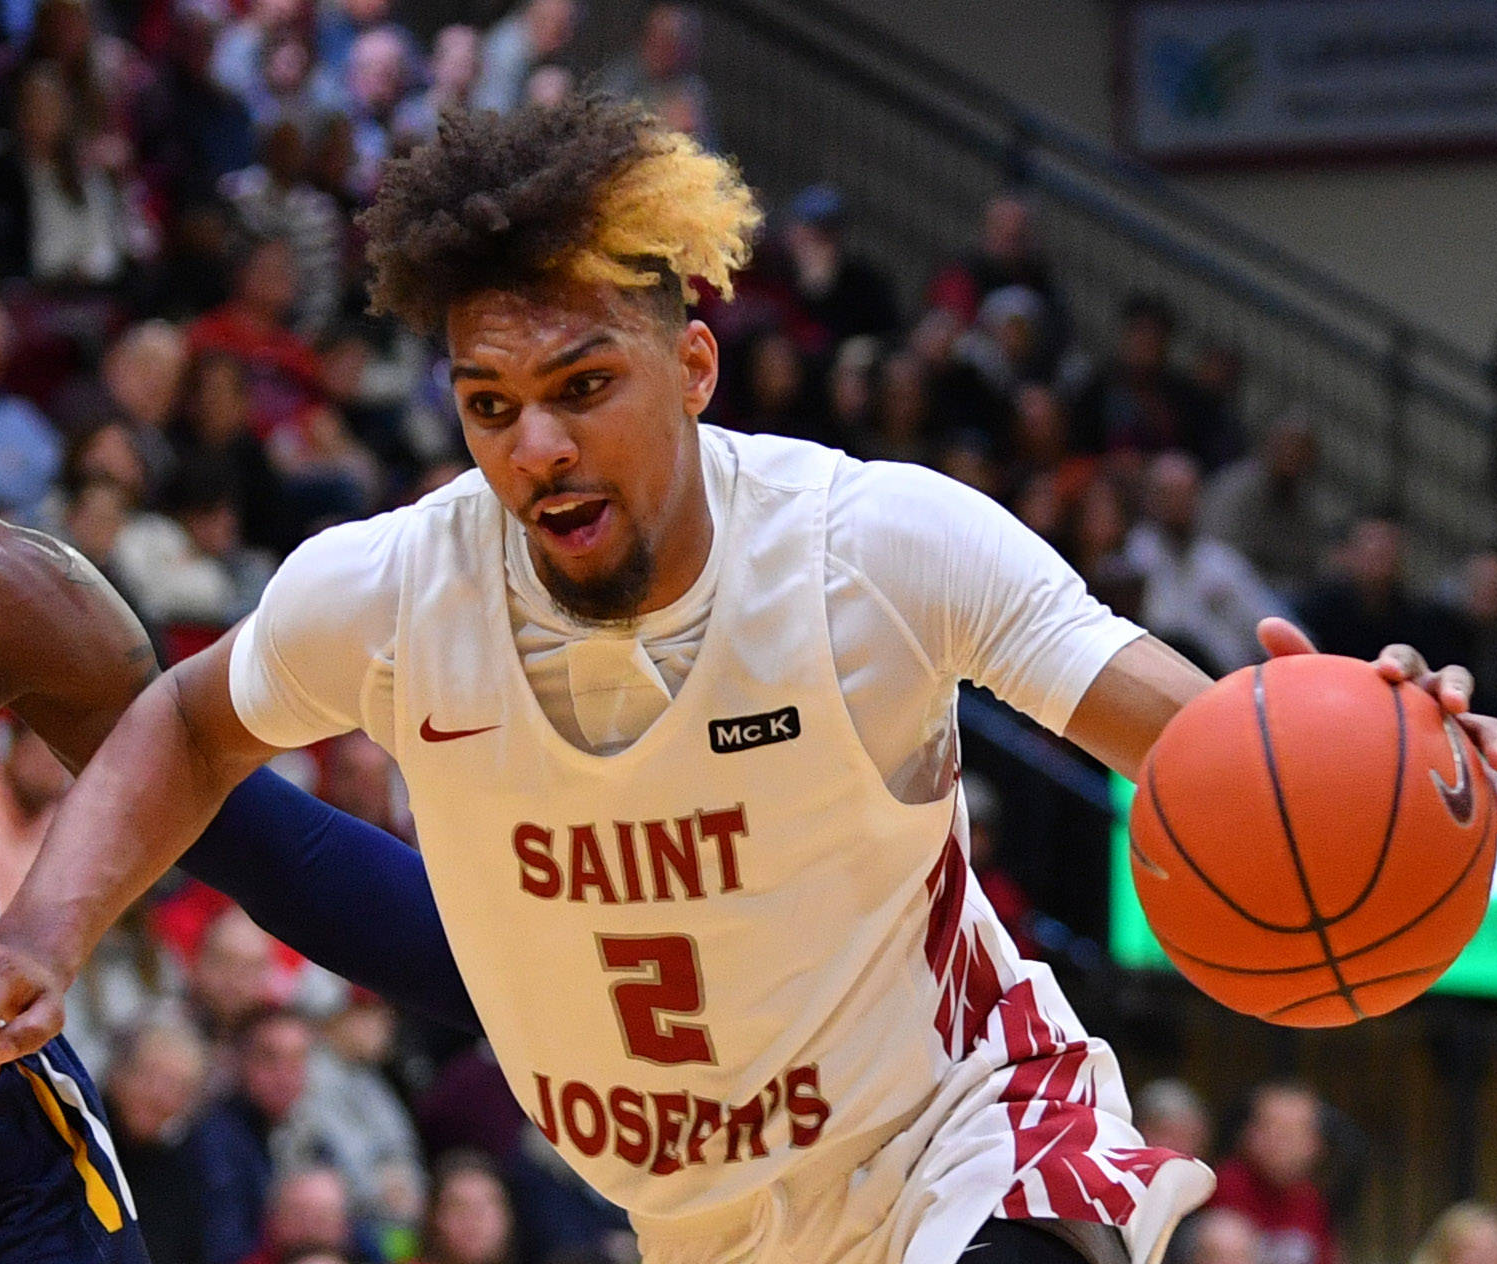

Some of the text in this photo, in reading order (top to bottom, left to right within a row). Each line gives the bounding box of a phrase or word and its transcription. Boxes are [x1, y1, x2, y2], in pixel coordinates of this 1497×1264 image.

[511, 803, 749, 905] SAINT
[593, 932, 719, 1066] 2
[531, 1062, 831, 1177] JOSEPH'S
